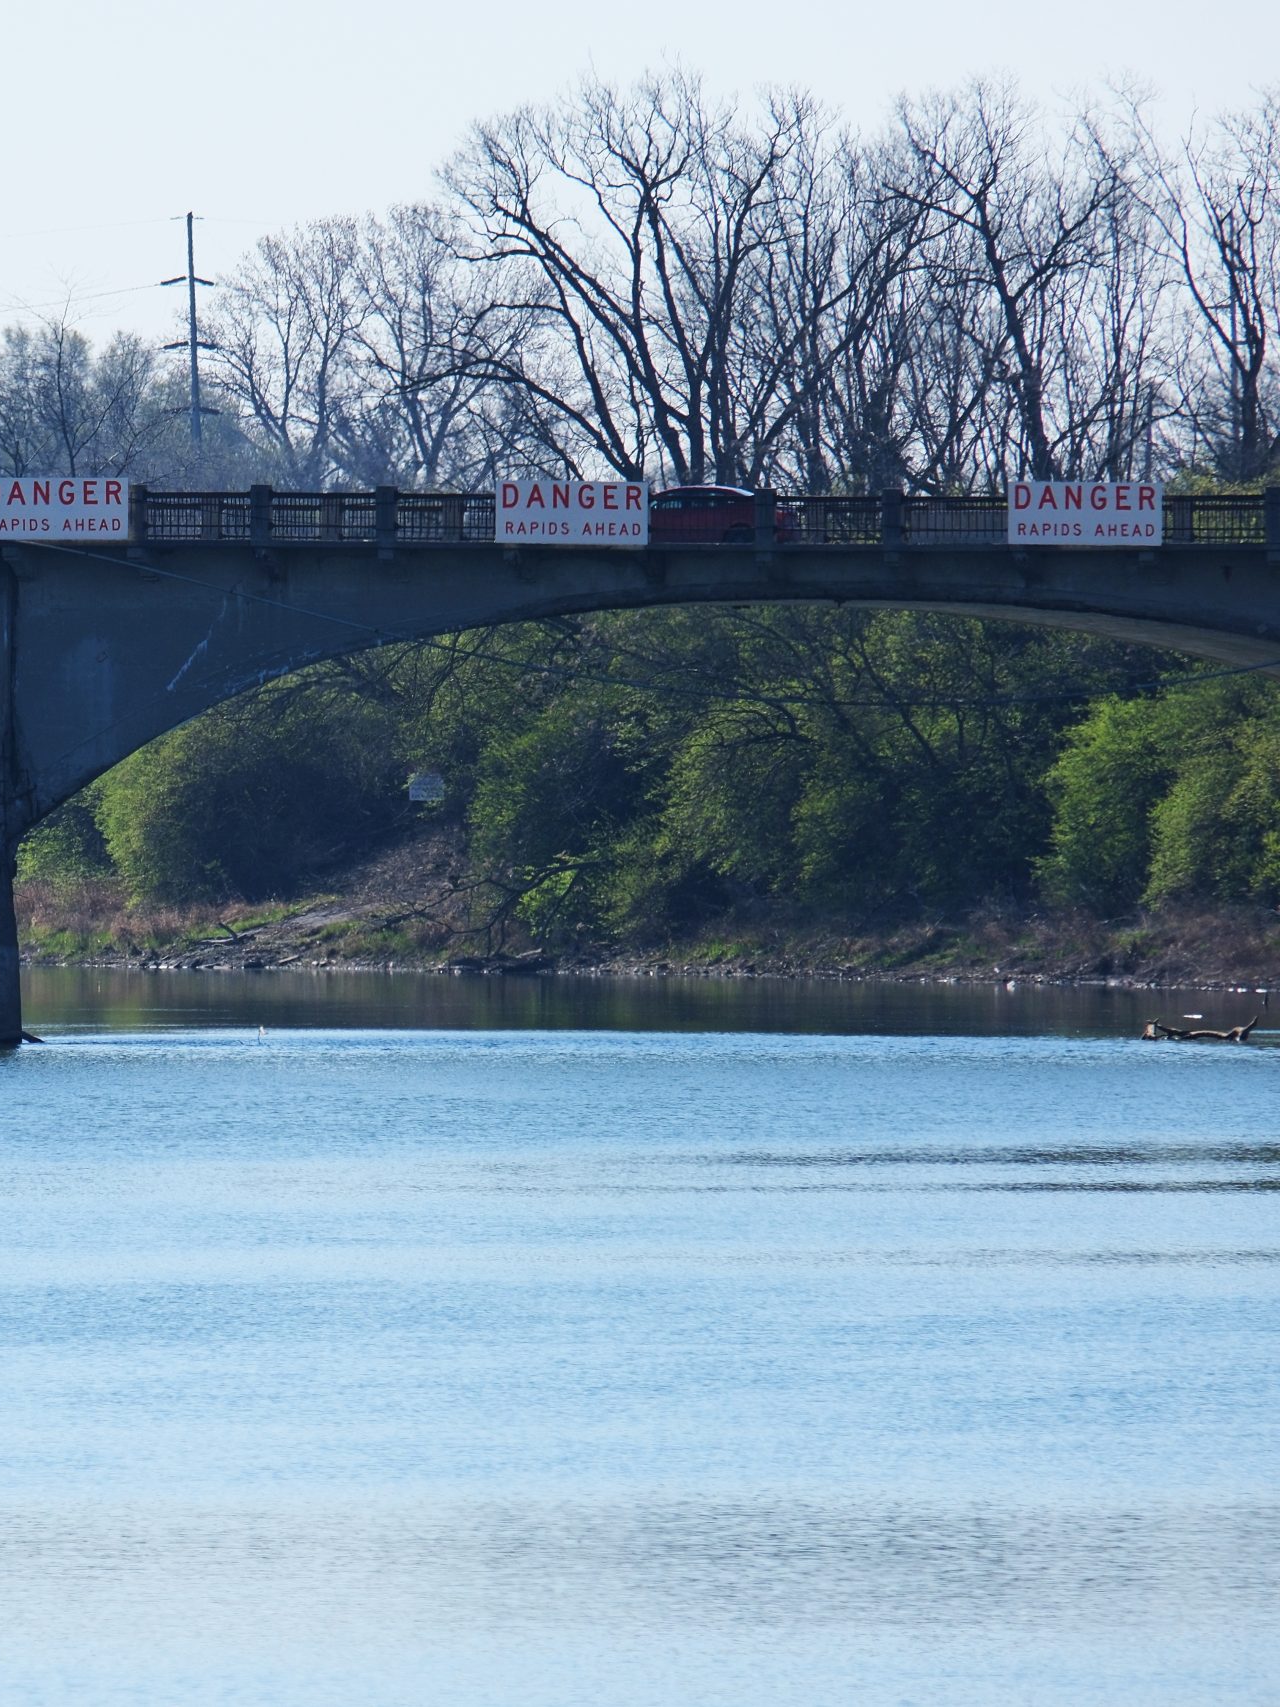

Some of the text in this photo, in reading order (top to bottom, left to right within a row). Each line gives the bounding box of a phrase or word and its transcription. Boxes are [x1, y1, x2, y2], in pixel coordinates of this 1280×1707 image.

[502, 483, 642, 510] DANGER
[1014, 484, 1155, 511] DANGER
[62, 518, 121, 531] AHEAD
[505, 521, 641, 536] RAPIDS AHEAD
[1017, 523, 1155, 537] RAPIDS AHEAD
